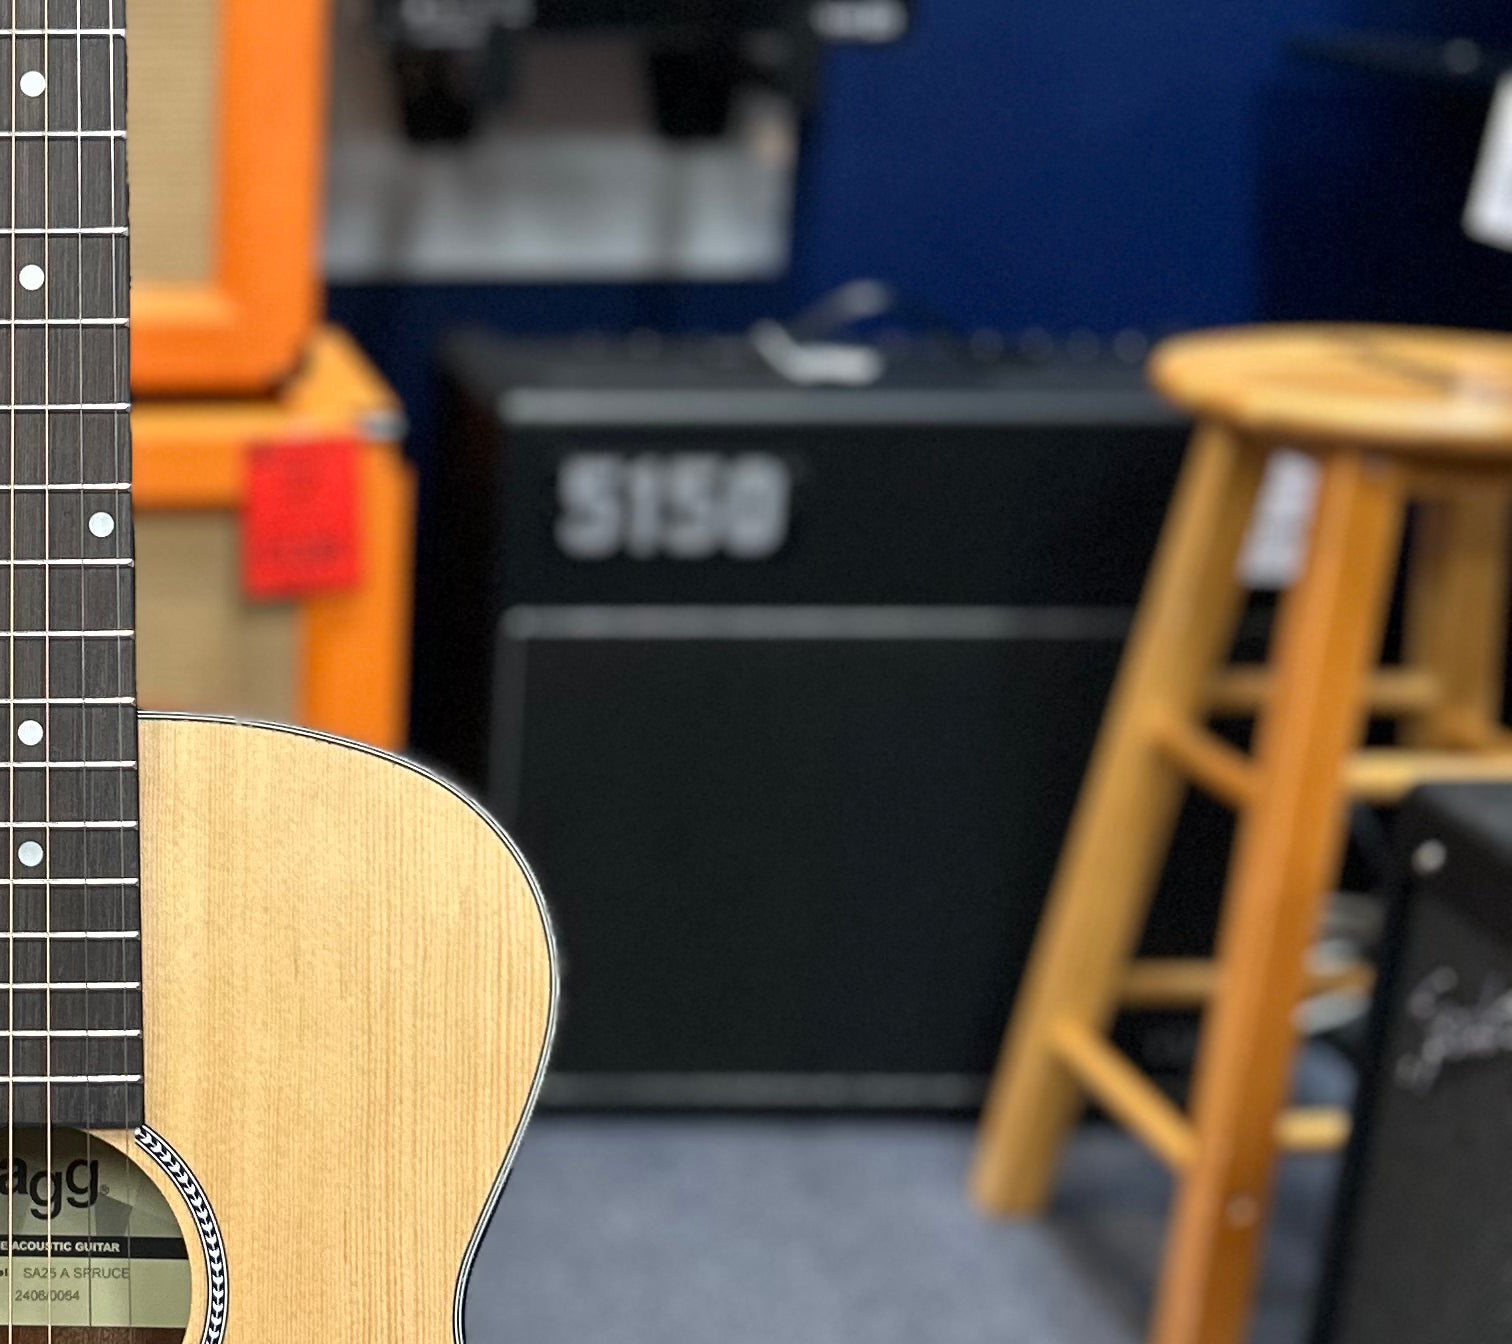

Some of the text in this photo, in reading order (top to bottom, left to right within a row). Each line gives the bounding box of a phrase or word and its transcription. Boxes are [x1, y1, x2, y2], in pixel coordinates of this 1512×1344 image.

[554, 453, 791, 557] 5150
[13, 1240, 72, 1252] ACOUSTIC
[75, 1241, 120, 1253] GUITAR
[23, 1267, 56, 1278] SA25
[60, 1267, 70, 1278] A
[74, 1267, 130, 1278] SPRUCE
